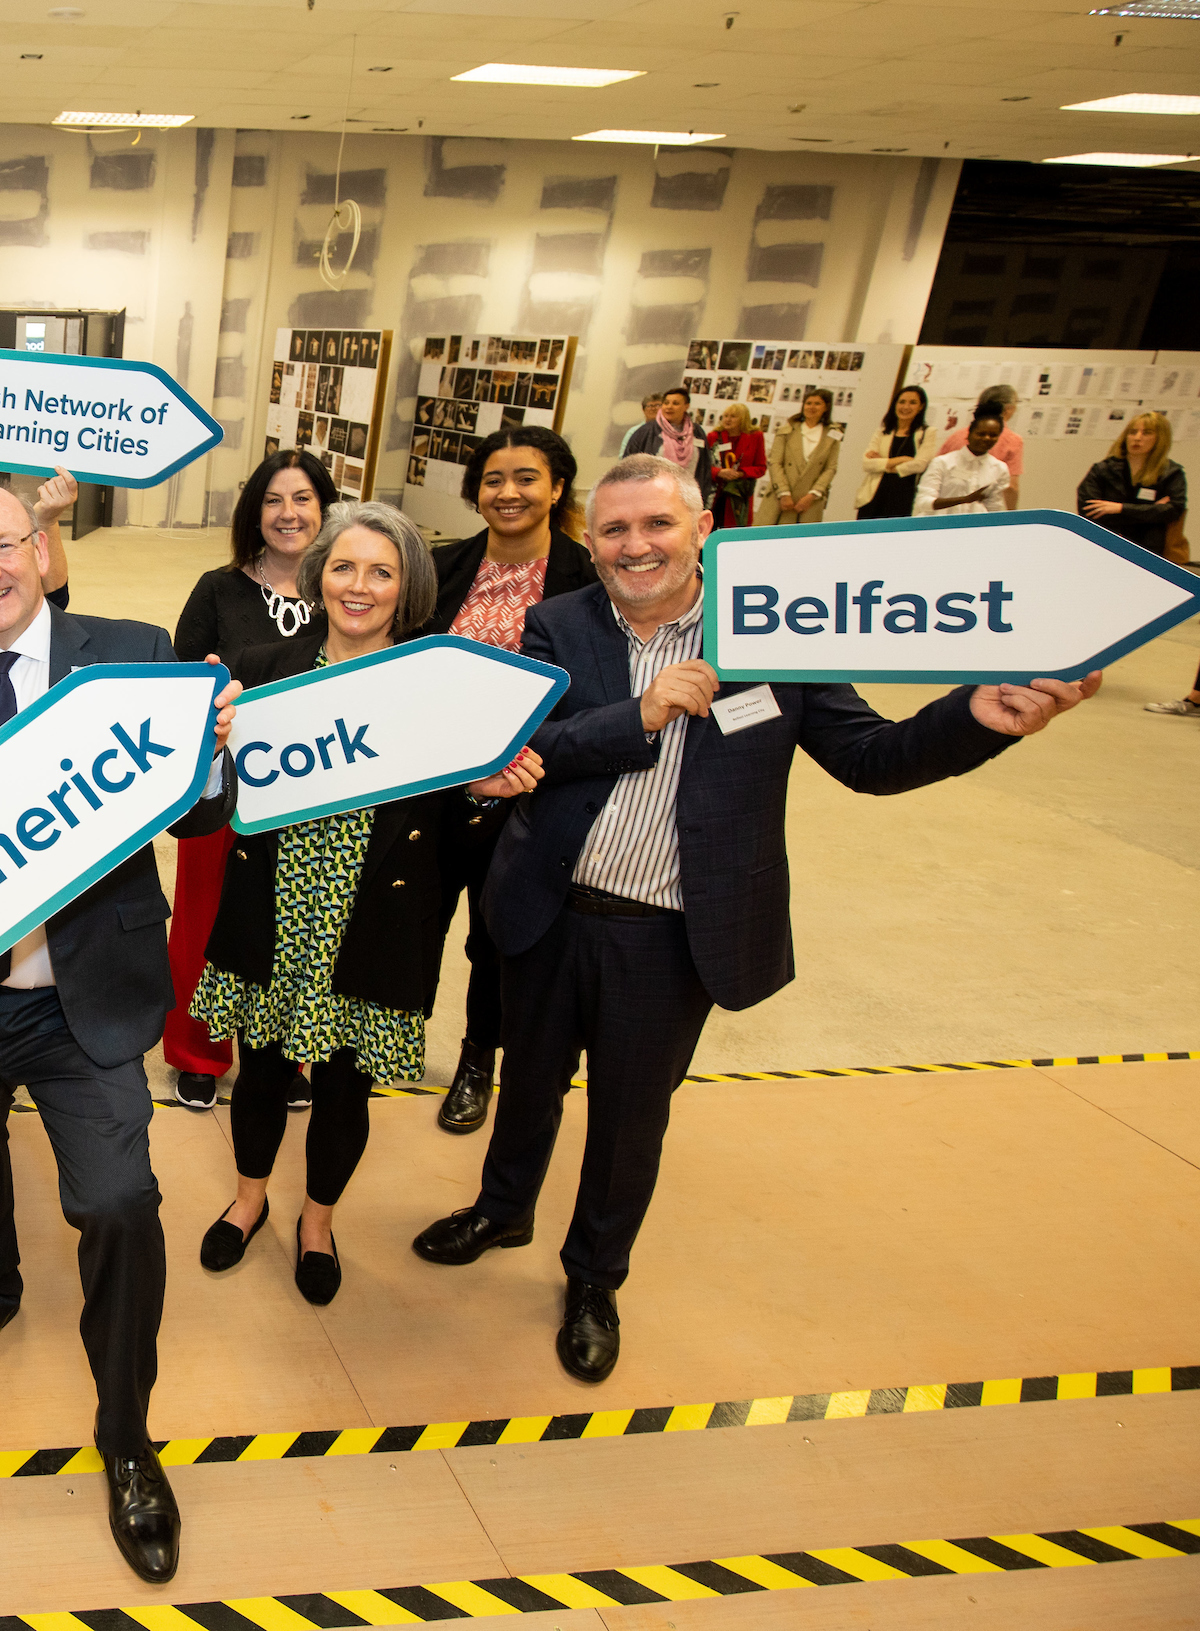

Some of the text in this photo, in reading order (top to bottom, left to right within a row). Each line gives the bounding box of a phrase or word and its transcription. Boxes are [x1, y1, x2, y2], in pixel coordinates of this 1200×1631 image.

[24, 389, 133, 421] Network
[140, 403, 170, 425] of
[77, 428, 149, 457] Cities
[732, 580, 1014, 636] Belfast
[728, 699, 762, 713] Danny Power
[236, 717, 380, 788] Cork
